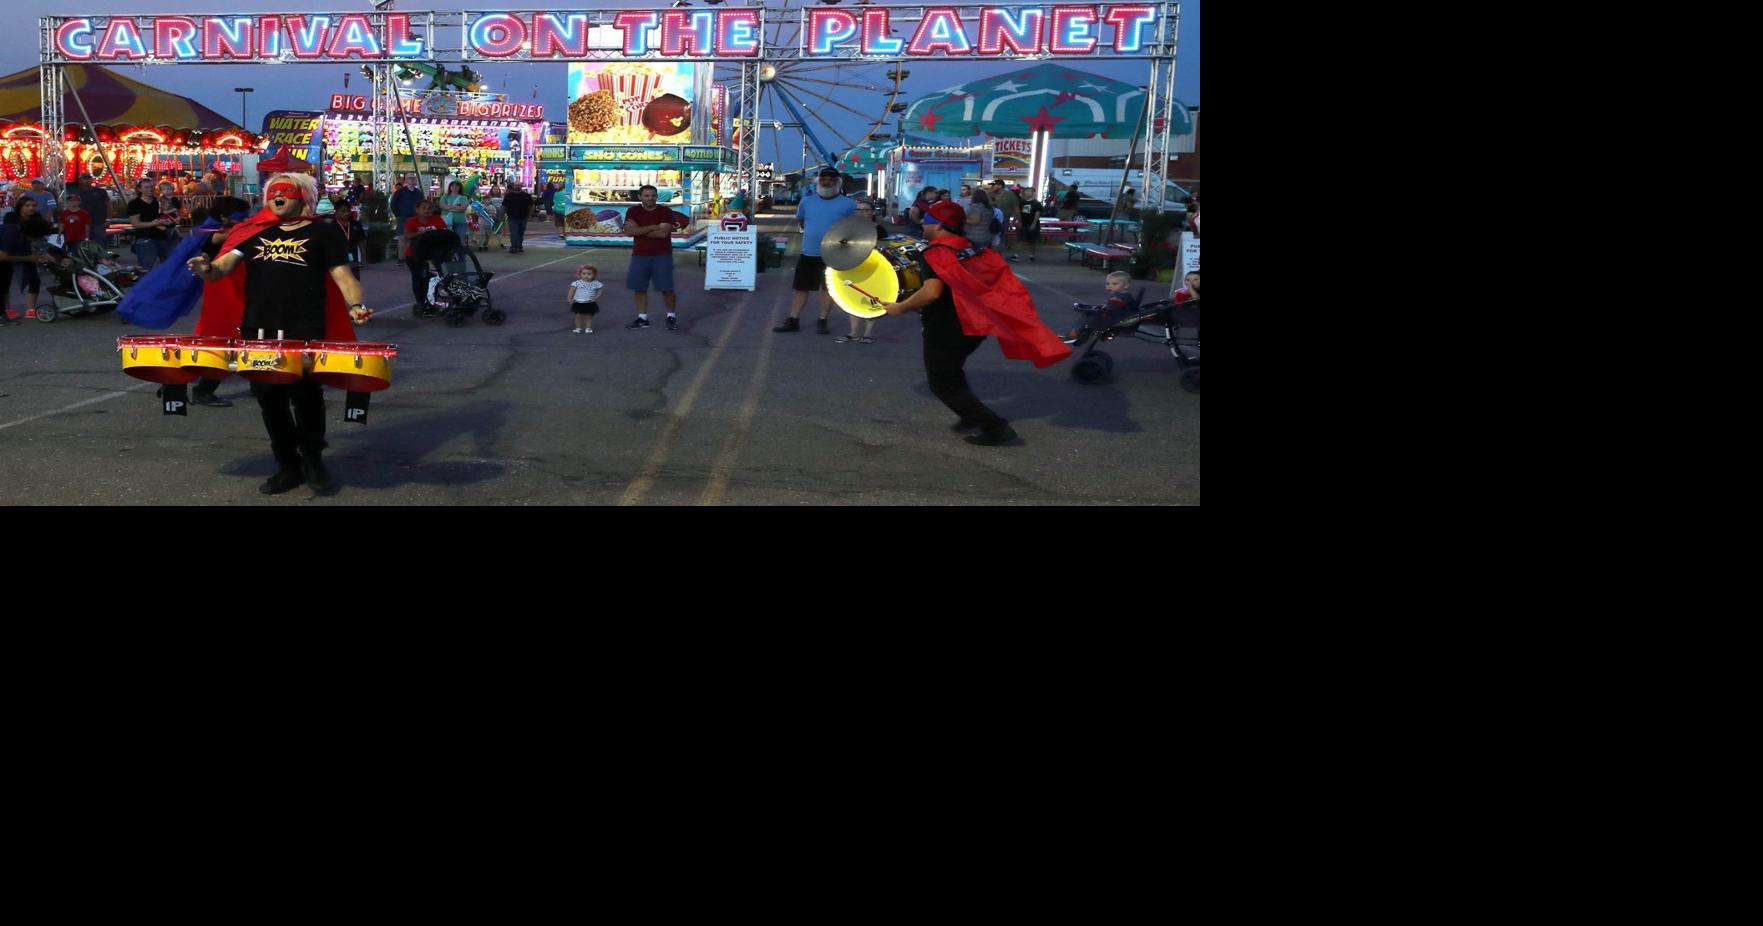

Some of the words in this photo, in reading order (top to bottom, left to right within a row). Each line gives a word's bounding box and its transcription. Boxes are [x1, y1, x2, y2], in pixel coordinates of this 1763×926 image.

[54, 13, 426, 60] CARNIVAL
[468, 11, 588, 57] ON
[613, 9, 759, 57] THE
[807, 5, 1157, 56] PLANET
[332, 95, 365, 109] BIG
[269, 118, 320, 130] WATER
[274, 132, 313, 144] RACE
[995, 140, 1032, 152] TICKETS
[584, 150, 616, 160] SNO
[618, 151, 665, 160] CONES
[263, 244, 299, 256] BOOM!
[165, 400, 184, 412] IP
[347, 408, 365, 419] IP
